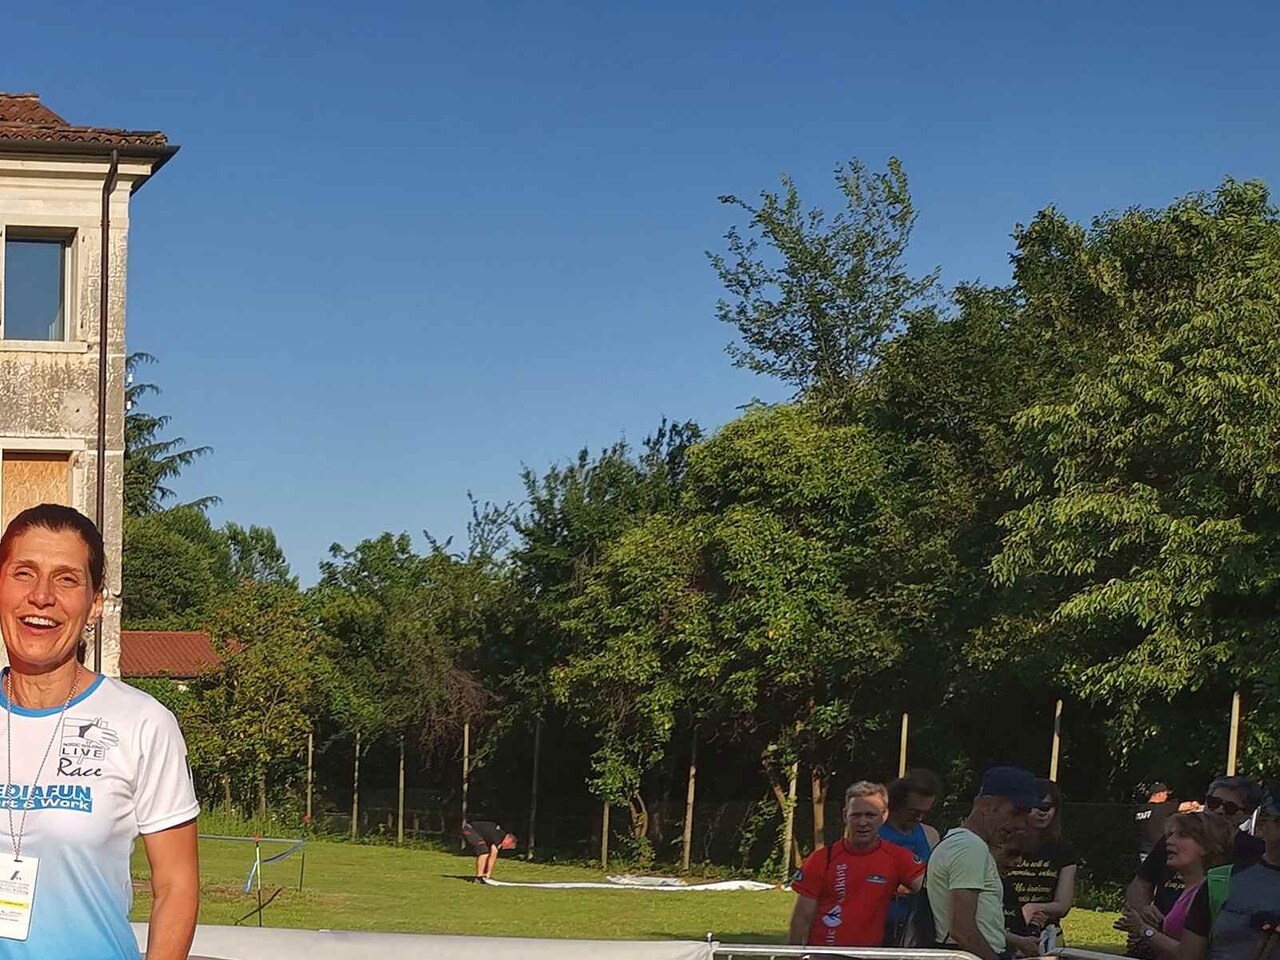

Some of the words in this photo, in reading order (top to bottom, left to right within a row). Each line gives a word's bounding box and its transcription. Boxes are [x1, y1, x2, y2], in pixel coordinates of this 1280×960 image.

[62, 747, 103, 758] LIVE
[56, 757, 103, 777] Race
[41, 797, 89, 811] Work
